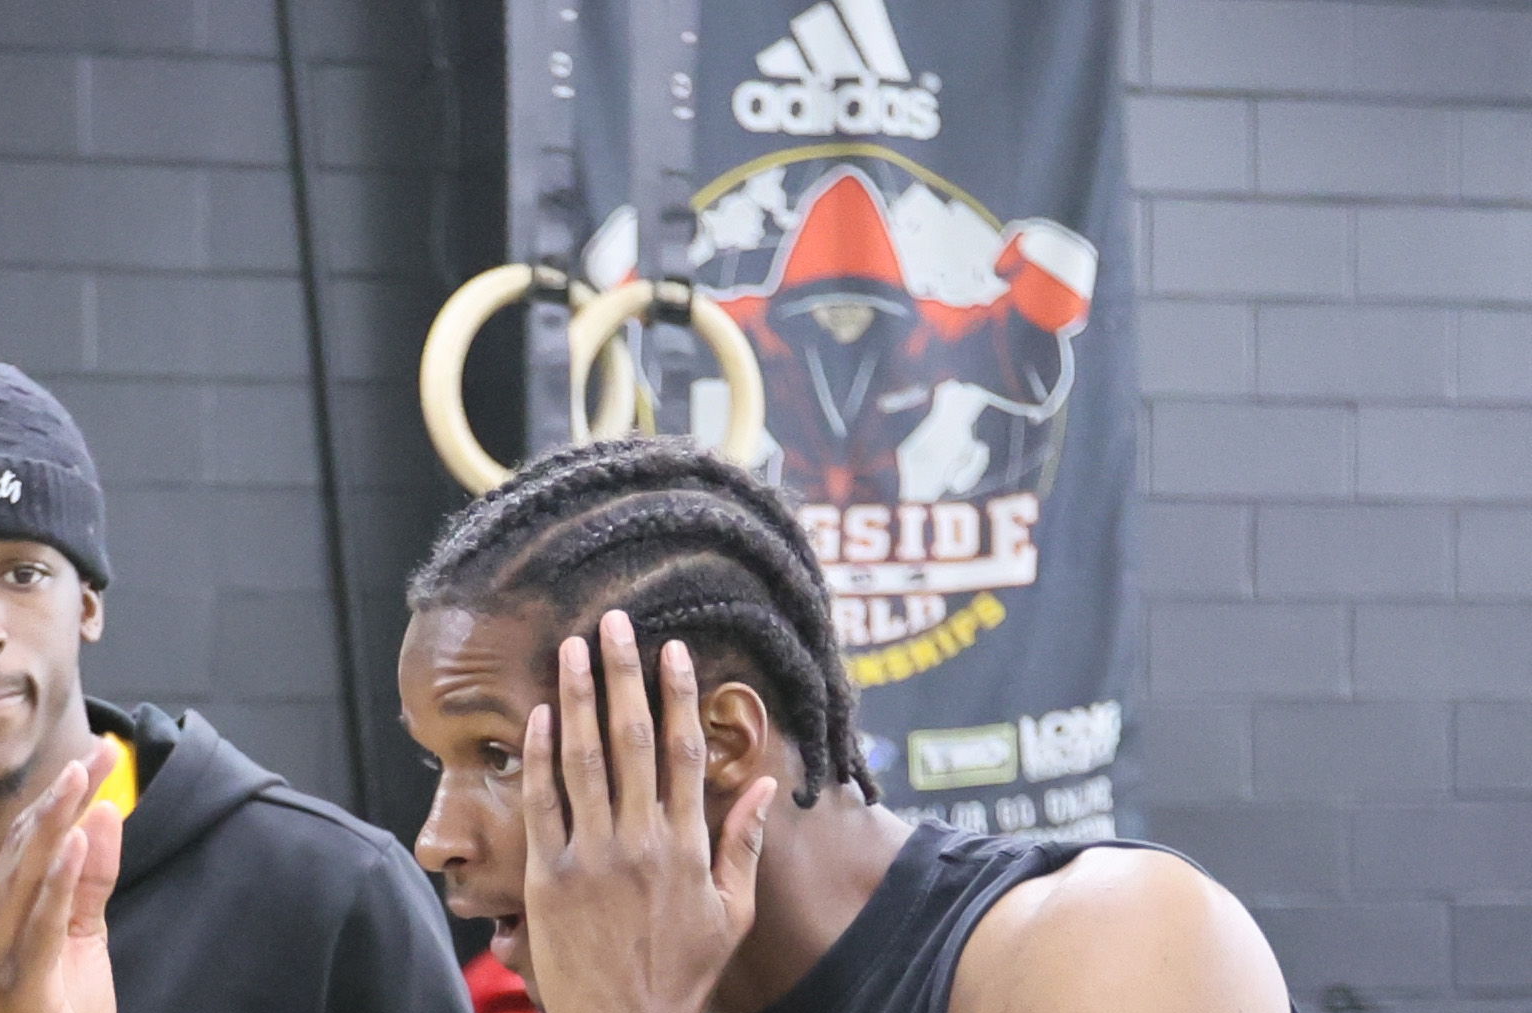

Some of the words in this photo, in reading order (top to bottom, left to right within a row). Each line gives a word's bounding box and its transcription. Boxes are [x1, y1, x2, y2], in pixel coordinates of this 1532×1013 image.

[732, 74, 942, 140] adidas
[795, 492, 1039, 582] GSIDE
[828, 594, 948, 647] RLD
